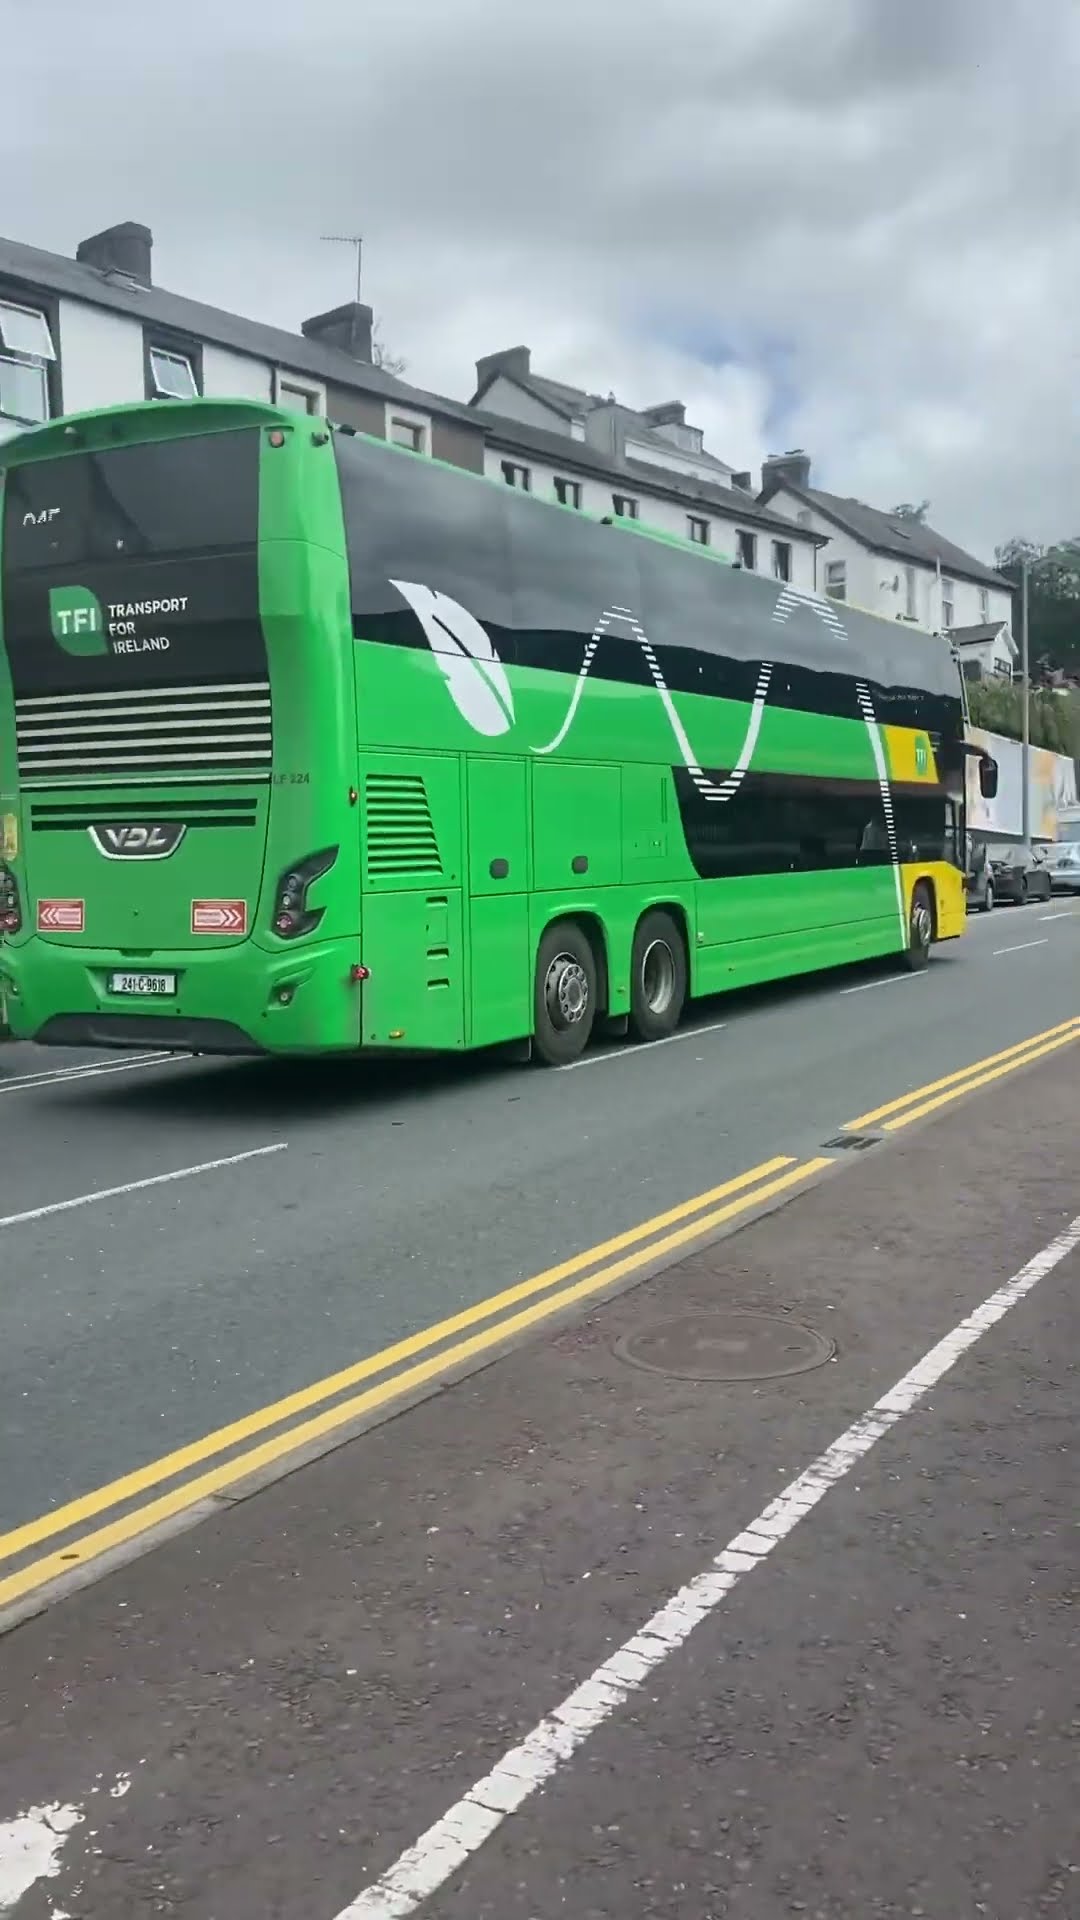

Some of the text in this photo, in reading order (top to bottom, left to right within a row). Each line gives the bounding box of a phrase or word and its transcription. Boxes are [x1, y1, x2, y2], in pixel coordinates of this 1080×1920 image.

[108, 597, 188, 618] TRANSPORT
[57, 607, 96, 634] TFI
[109, 621, 136, 636] FOR
[113, 637, 170, 654] IRELAND
[105, 827, 167, 848] VDL
